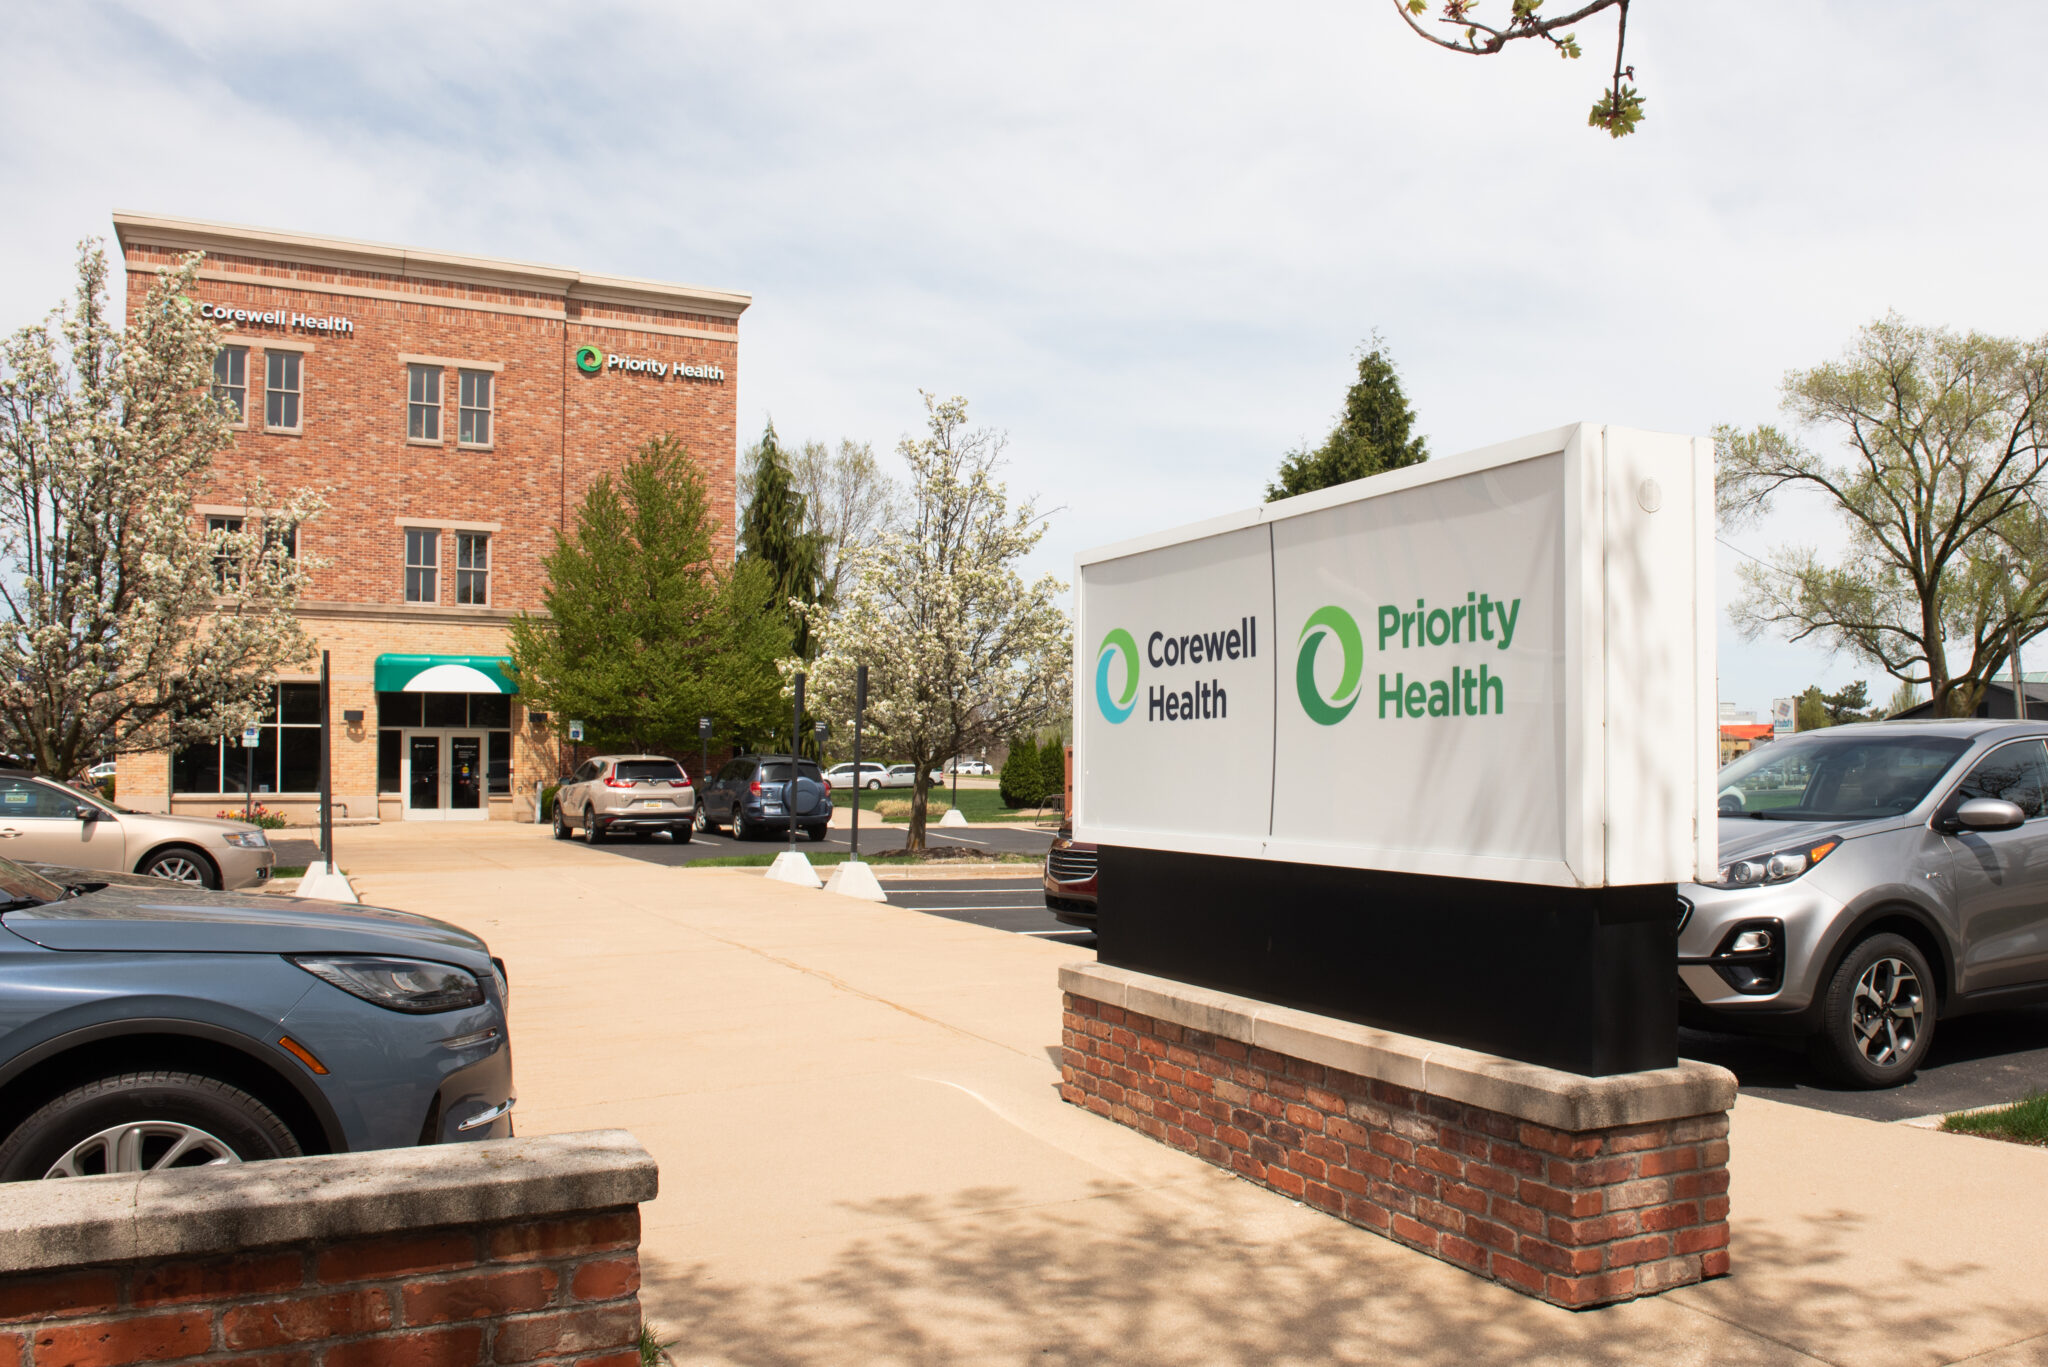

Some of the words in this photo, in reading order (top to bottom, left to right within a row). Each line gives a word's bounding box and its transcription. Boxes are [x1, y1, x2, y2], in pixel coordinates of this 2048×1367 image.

[201, 302, 286, 326] Corewell
[291, 312, 354, 332] Health
[608, 354, 668, 376] Priority
[673, 361, 724, 380] Health
[1147, 615, 1256, 668] Corewell
[1378, 591, 1521, 651] Priority
[1149, 678, 1227, 722] Health
[1379, 663, 1503, 719] Health
